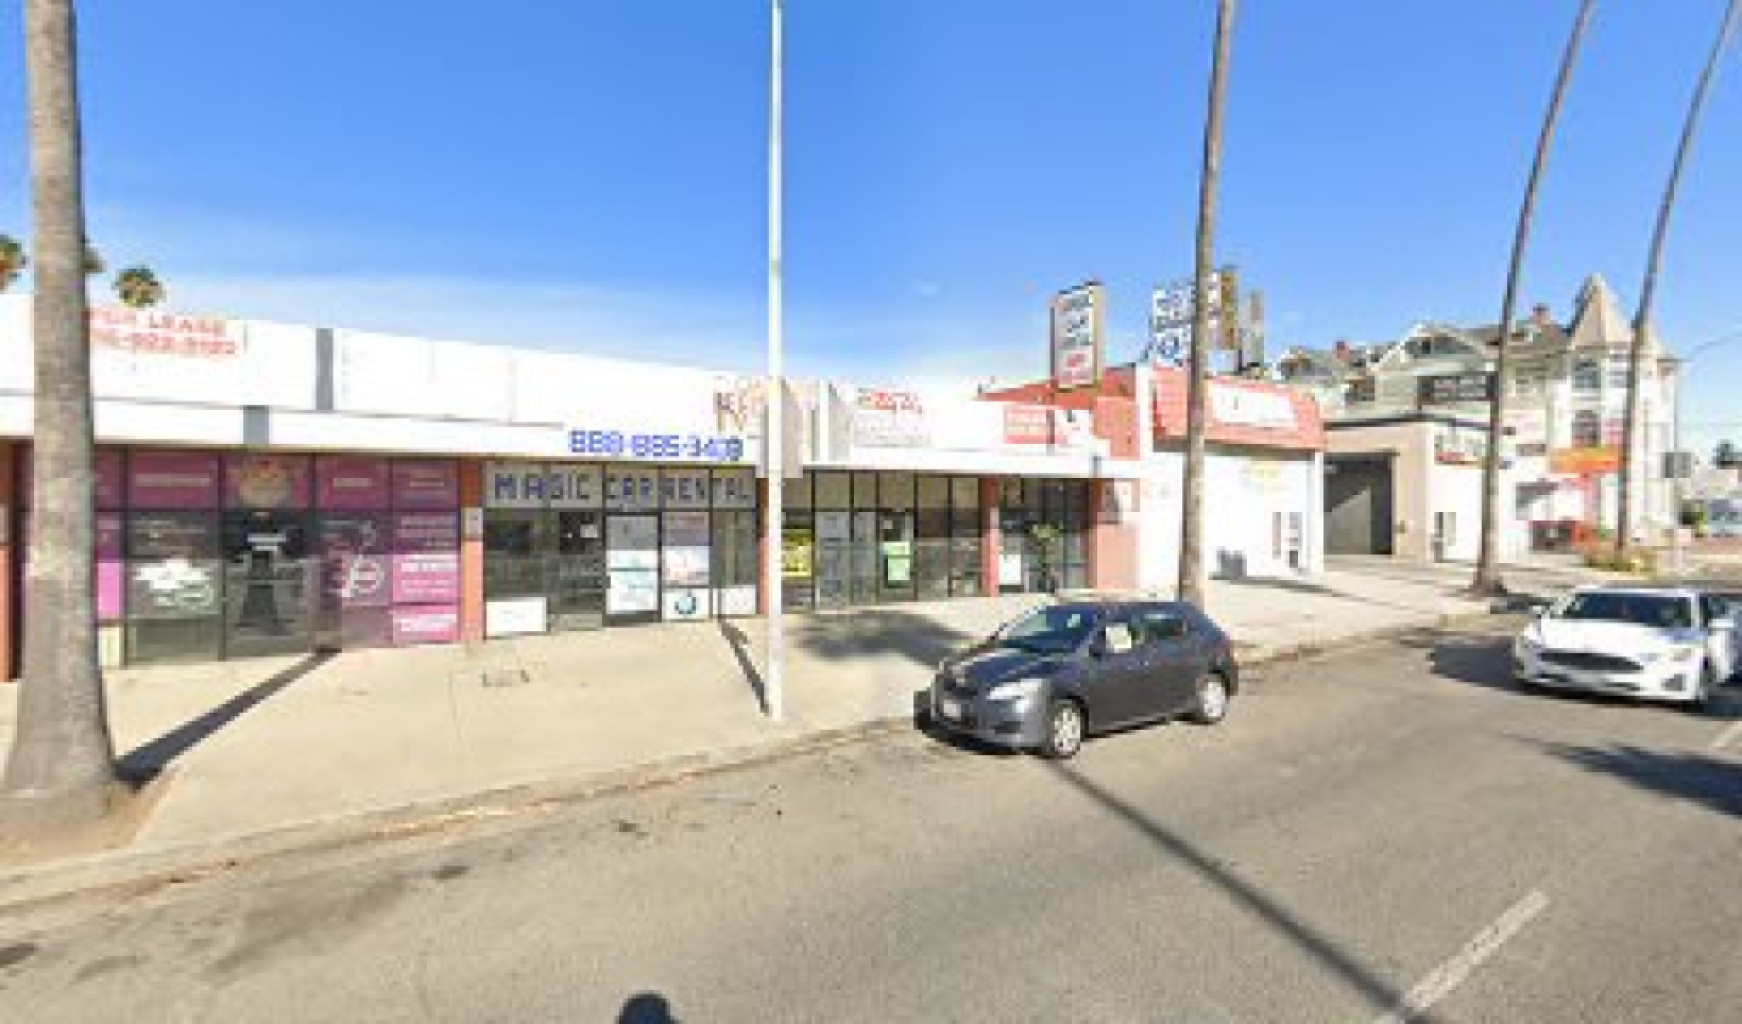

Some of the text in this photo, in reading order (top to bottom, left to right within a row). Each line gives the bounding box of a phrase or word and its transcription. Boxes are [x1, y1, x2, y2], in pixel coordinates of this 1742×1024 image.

[494, 473, 749, 500] MAGIC CAR RENTAL
